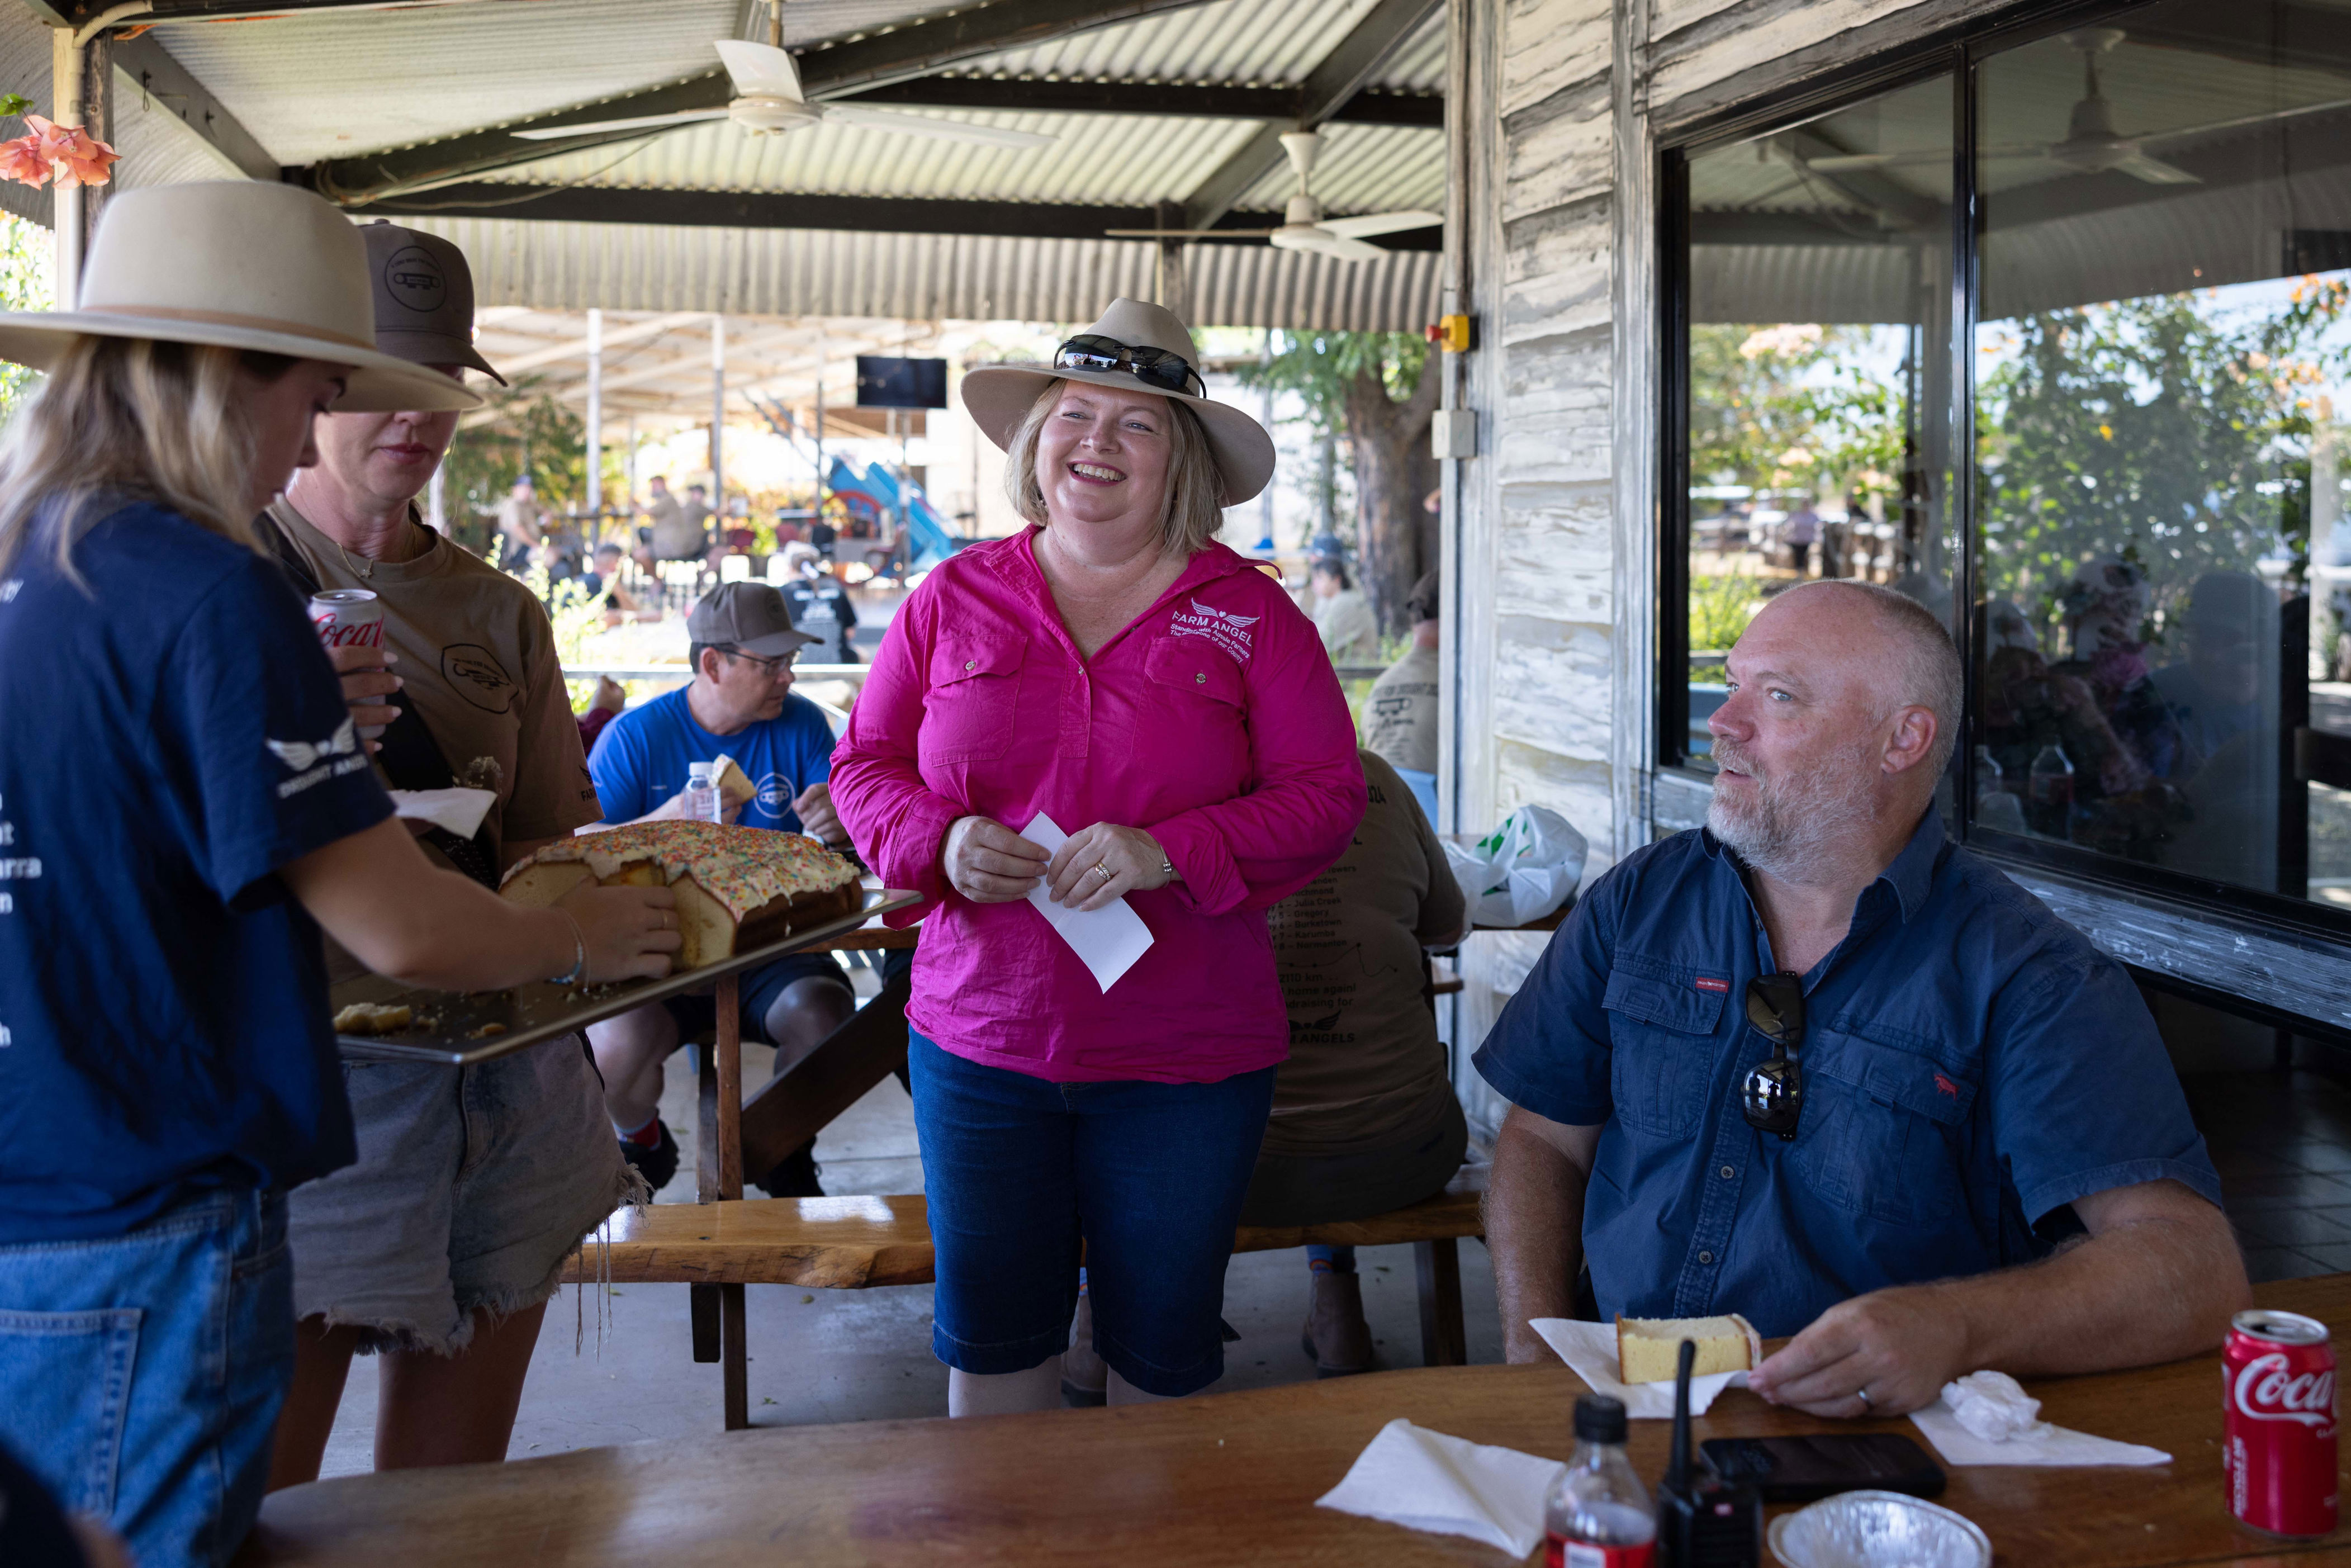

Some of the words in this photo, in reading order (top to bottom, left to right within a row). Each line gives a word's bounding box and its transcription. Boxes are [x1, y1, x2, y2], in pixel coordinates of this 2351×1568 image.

[1172, 610, 1209, 626] FARM
[1212, 629, 1231, 643] Aussie
[1231, 641, 1250, 659] Farmers
[1227, 647, 1244, 664] Country
[1295, 899, 1315, 907] Julia
[1295, 909, 1329, 918] Gregory
[1295, 919, 1342, 928] Burketown
[1295, 930, 1335, 939] Karumba
[1297, 940, 1347, 949] Normanton
[1324, 982, 1356, 995] again!
[1338, 997, 1353, 1006] for
[1300, 1033, 1355, 1044] ANGELS
[2235, 1353, 2336, 1427] Coca
